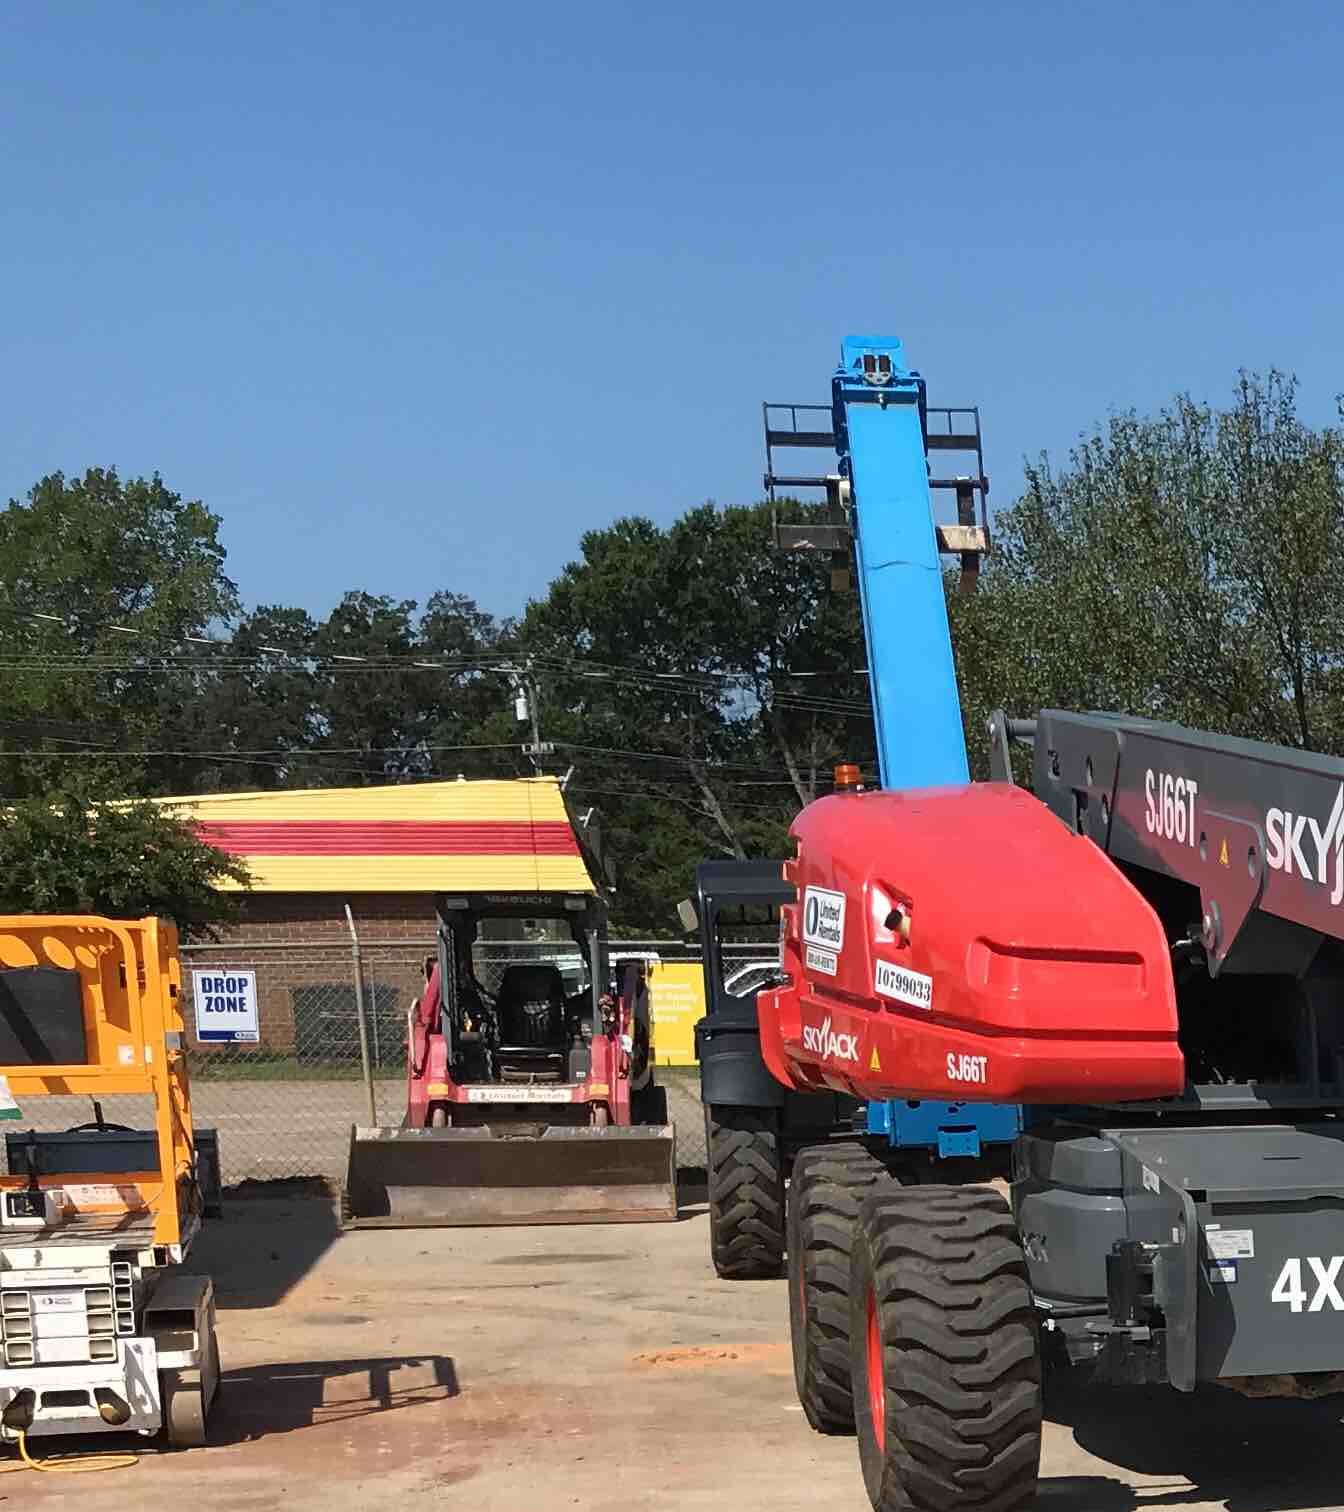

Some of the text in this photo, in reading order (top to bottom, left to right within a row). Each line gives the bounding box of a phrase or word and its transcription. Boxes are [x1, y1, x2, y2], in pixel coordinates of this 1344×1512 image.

[1145, 768, 1198, 848] SJ66T
[820, 899, 841, 922] United
[818, 920, 841, 943] Rentals
[201, 976, 249, 993] DROP
[877, 966, 931, 1002] 10799033
[205, 996, 248, 1013] ZONE
[803, 1015, 859, 1062] SKYJACK
[946, 1052, 988, 1084] SJ66T
